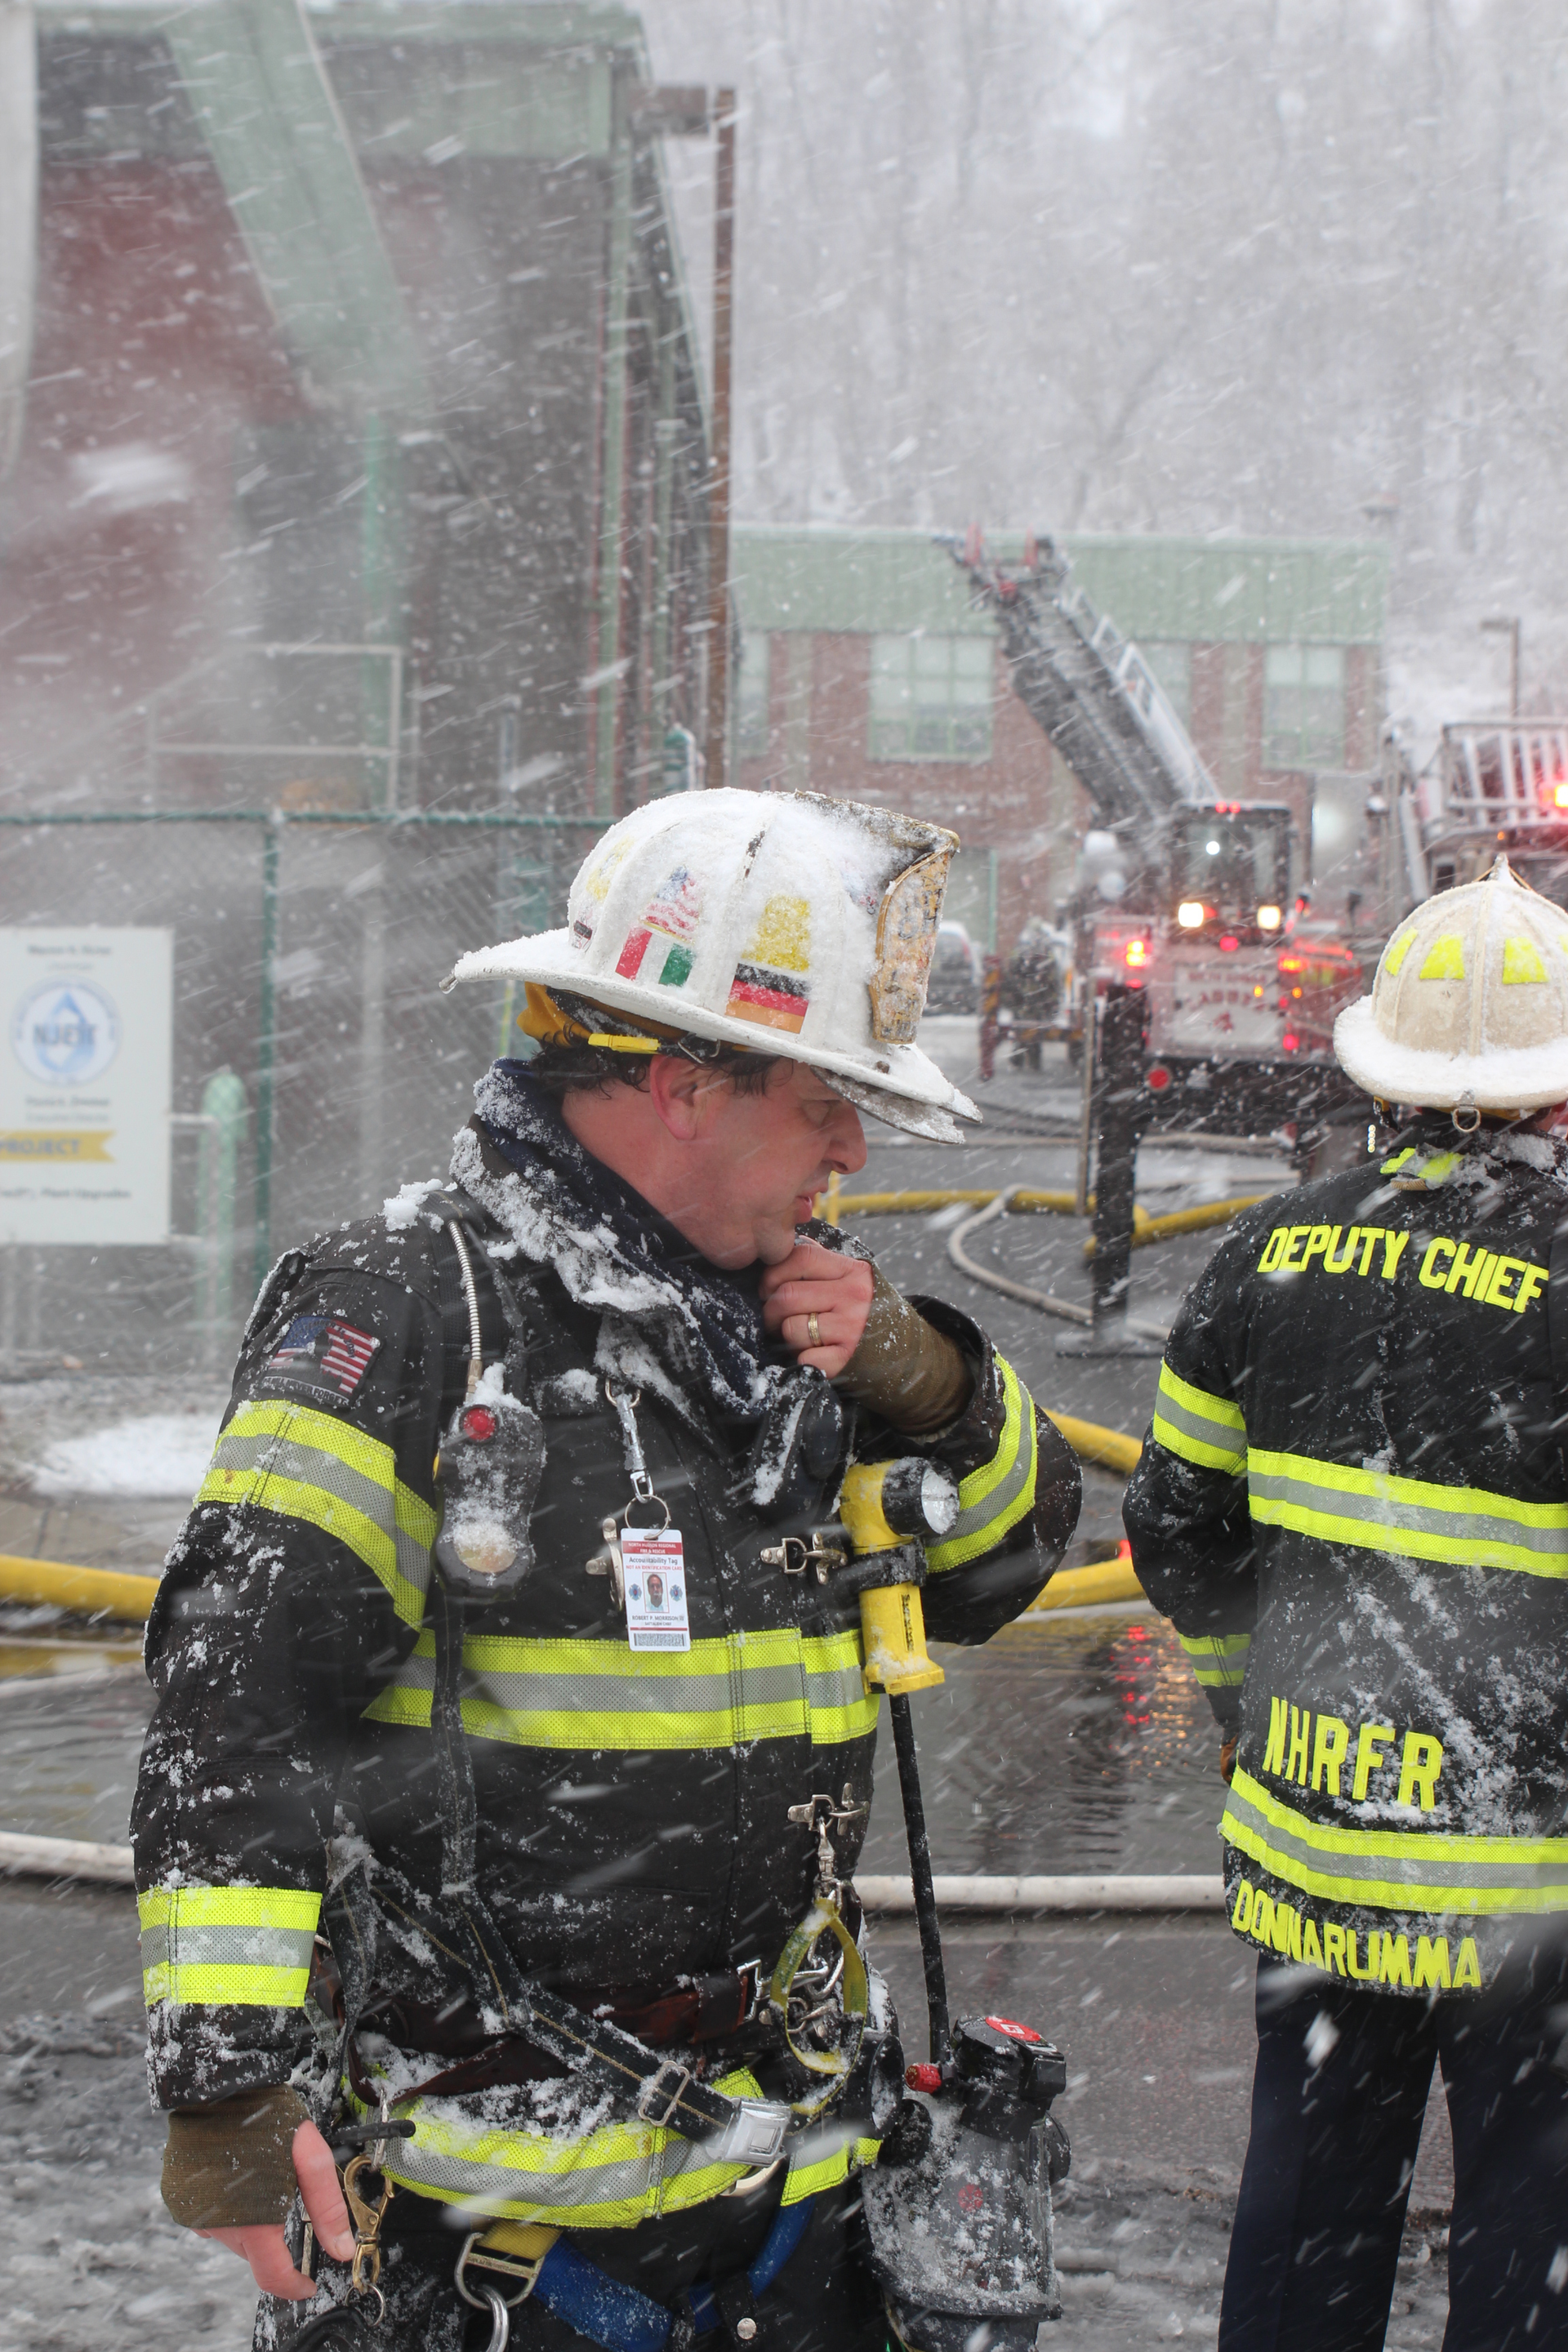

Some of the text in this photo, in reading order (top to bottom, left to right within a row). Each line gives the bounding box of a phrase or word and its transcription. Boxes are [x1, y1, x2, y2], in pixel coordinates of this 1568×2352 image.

[1257, 1225, 1550, 1314] DEPUTY CHIEF
[668, 1557, 678, 1566] Tag
[1263, 1696, 1443, 1812] NHRFR
[1232, 1878, 1482, 1989] DONNARUMMA
